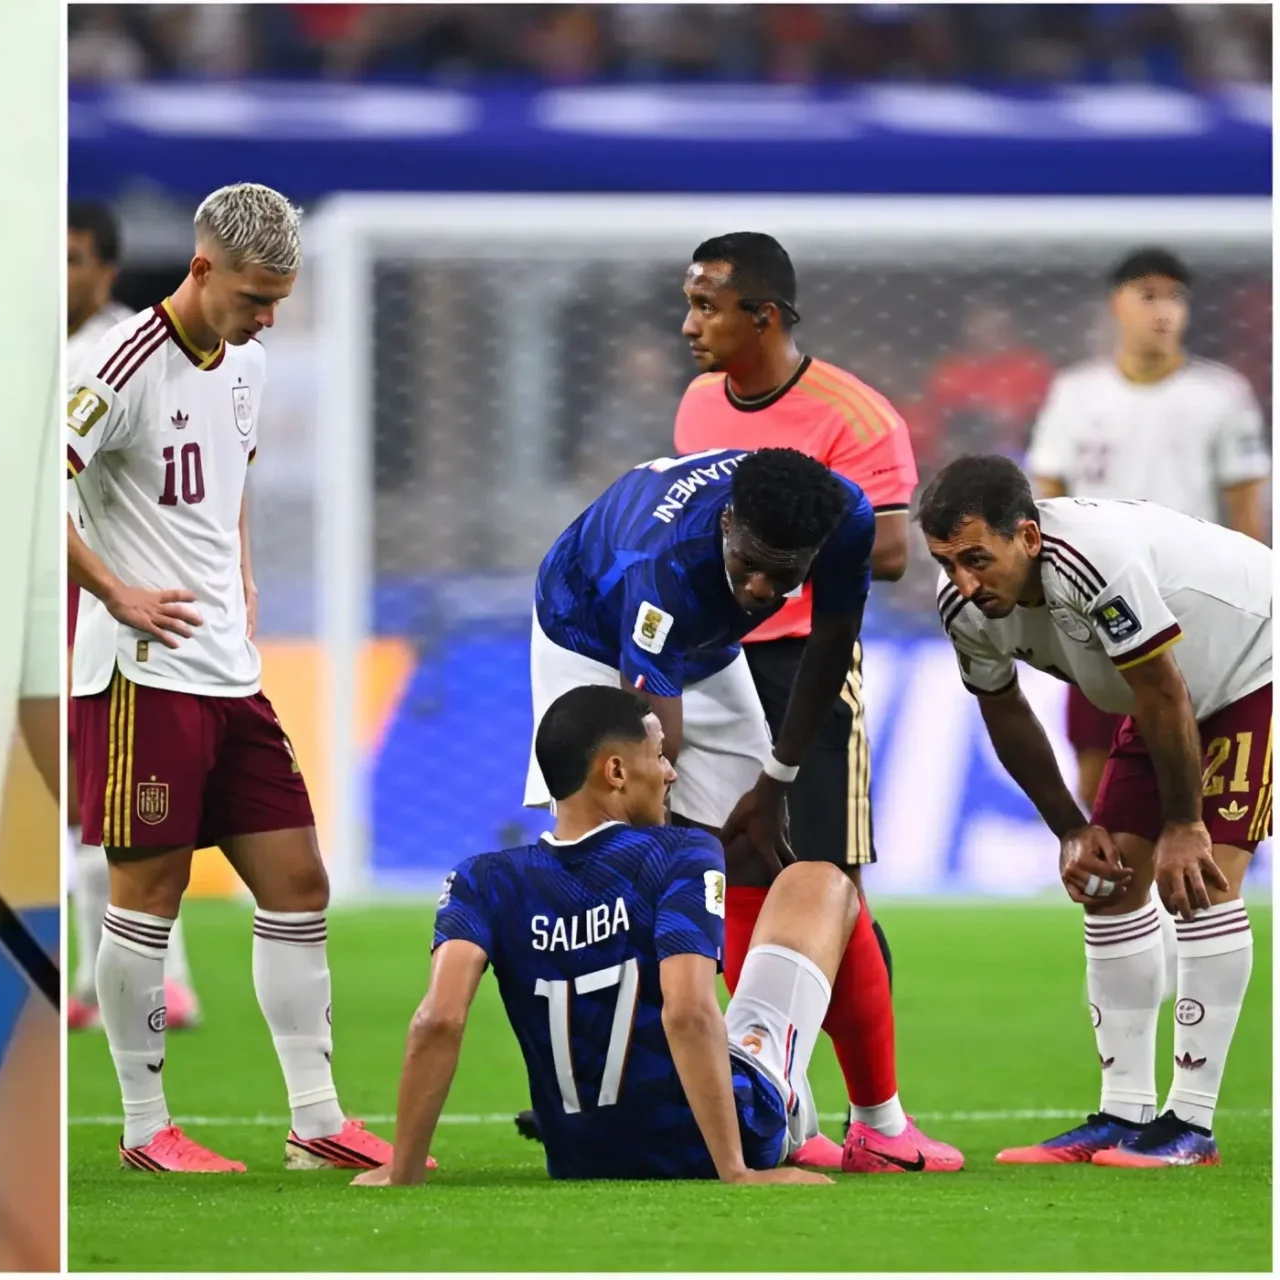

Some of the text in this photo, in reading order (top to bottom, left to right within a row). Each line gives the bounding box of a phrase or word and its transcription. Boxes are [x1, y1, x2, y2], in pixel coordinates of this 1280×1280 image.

[158, 442, 205, 506] 10
[652, 453, 748, 523] UAMENI
[1201, 732, 1253, 796] 21
[531, 897, 630, 952] SALIBA
[534, 958, 639, 1114] 17
